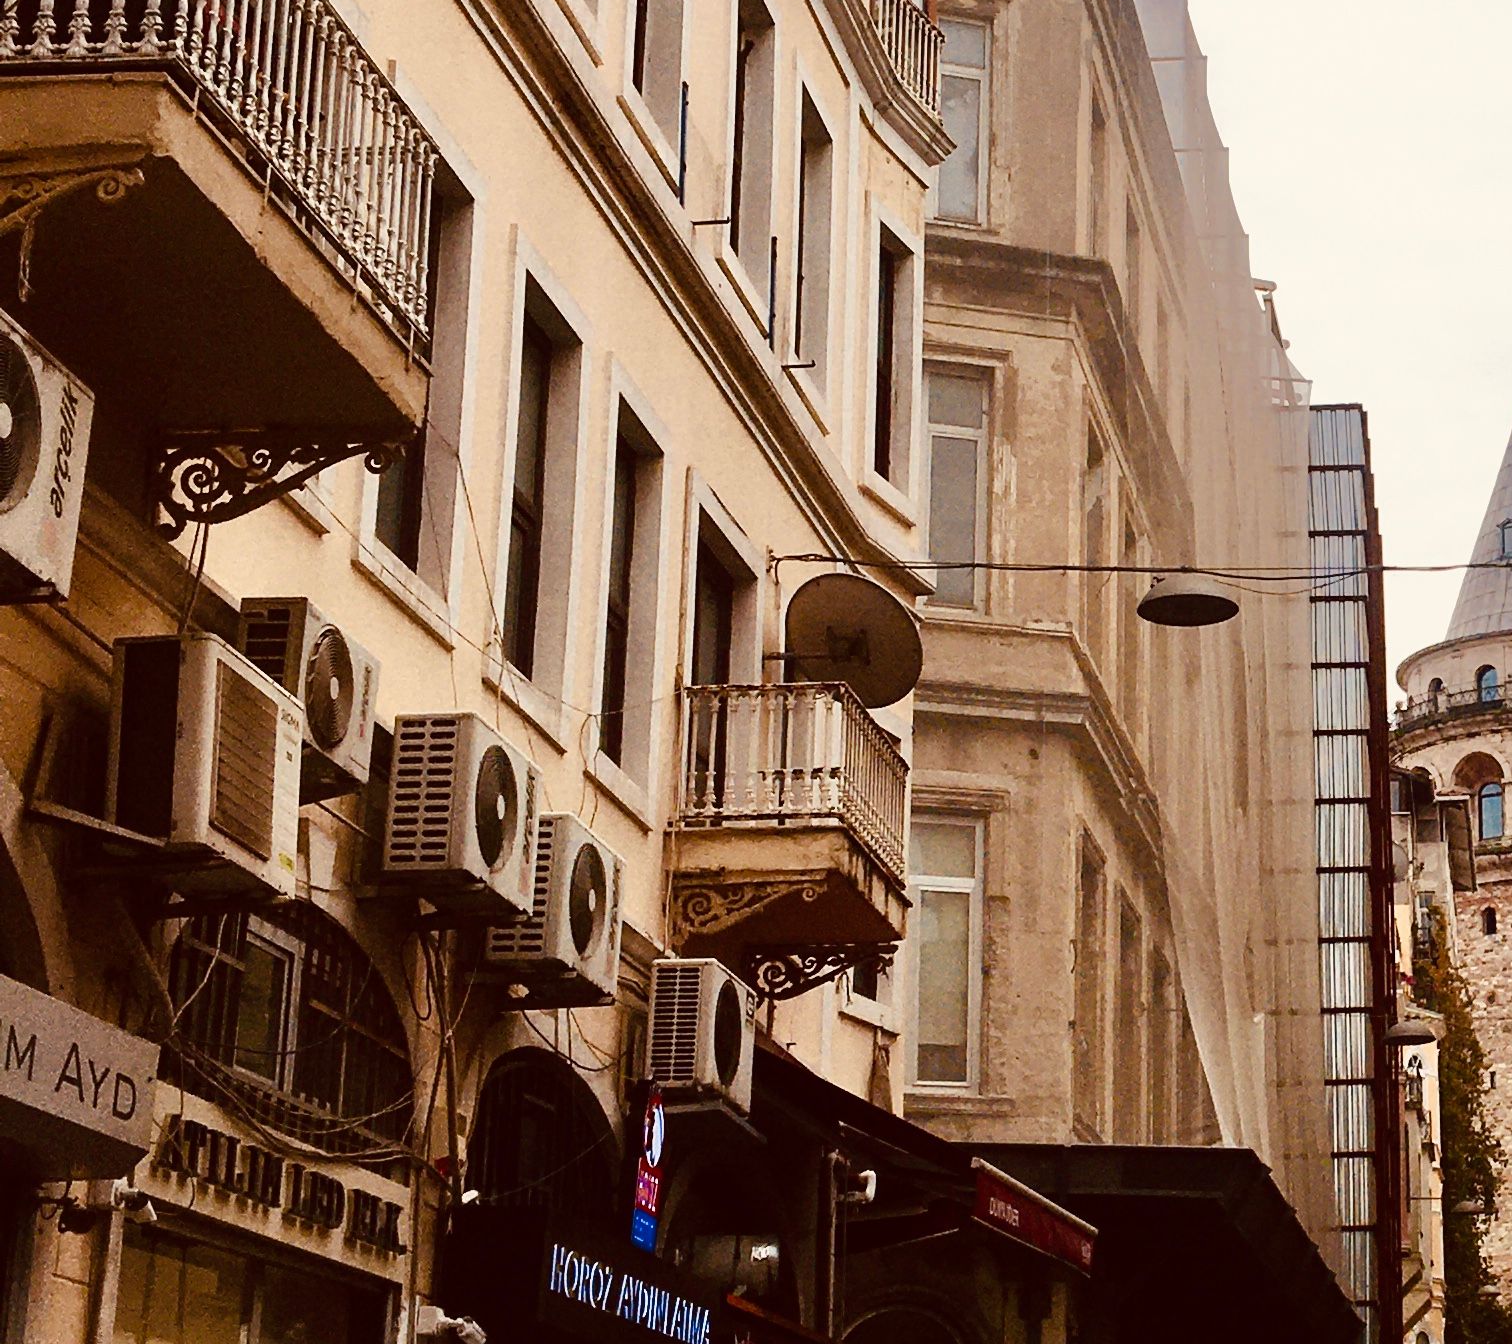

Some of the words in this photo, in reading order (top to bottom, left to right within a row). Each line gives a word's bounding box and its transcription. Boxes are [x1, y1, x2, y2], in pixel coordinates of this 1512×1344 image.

[49, 380, 79, 518] arçelik
[0, 1020, 38, 1082] M
[54, 1042, 153, 1120] AYD
[549, 1243, 614, 1312] HOROZ
